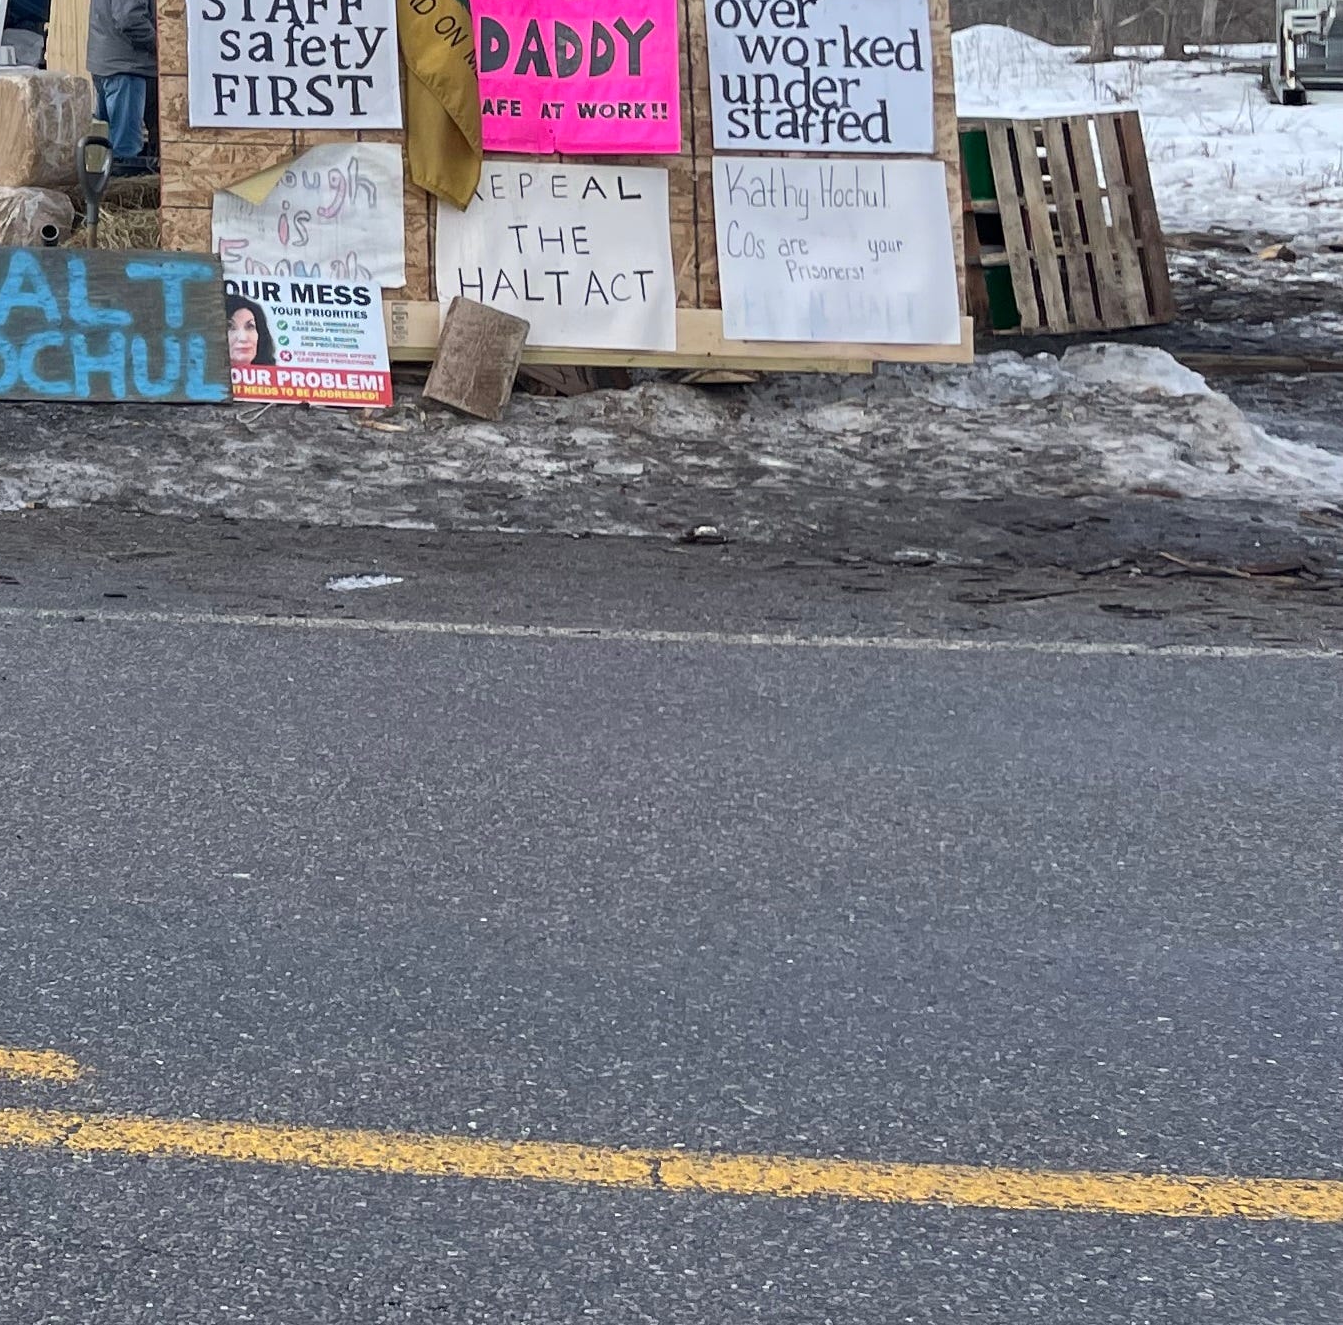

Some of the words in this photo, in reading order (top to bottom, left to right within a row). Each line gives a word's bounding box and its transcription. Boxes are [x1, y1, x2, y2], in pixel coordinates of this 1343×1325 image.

[219, 22, 388, 70] safety
[434, 15, 469, 48] ON
[480, 16, 656, 79] DADDY
[735, 24, 925, 72] worked
[212, 73, 374, 117] FIRST
[720, 67, 861, 110] under
[481, 98, 522, 117] AFE
[540, 103, 565, 119] AT
[576, 102, 668, 120] WORK!!
[727, 99, 892, 144] staffed
[276, 156, 377, 219] ough
[474, 172, 642, 202] EPEAL
[725, 163, 809, 221] Kathy
[278, 200, 312, 247] is
[508, 224, 590, 255] THE
[778, 237, 809, 257] are
[867, 238, 903, 262] your
[458, 267, 570, 306] HALT
[584, 269, 654, 307] ACT
[785, 259, 865, 283] Prisoners!
[290, 282, 372, 307] MESS
[271, 306, 301, 317] YOUR
[304, 308, 368, 320] PRIORITIES
[243, 386, 279, 396] NEEDS
[281, 387, 294, 397] TO
[296, 388, 310, 398] BE
[312, 389, 380, 401] ADDRESSED!
[276, 370, 385, 391] PROBLEM!
